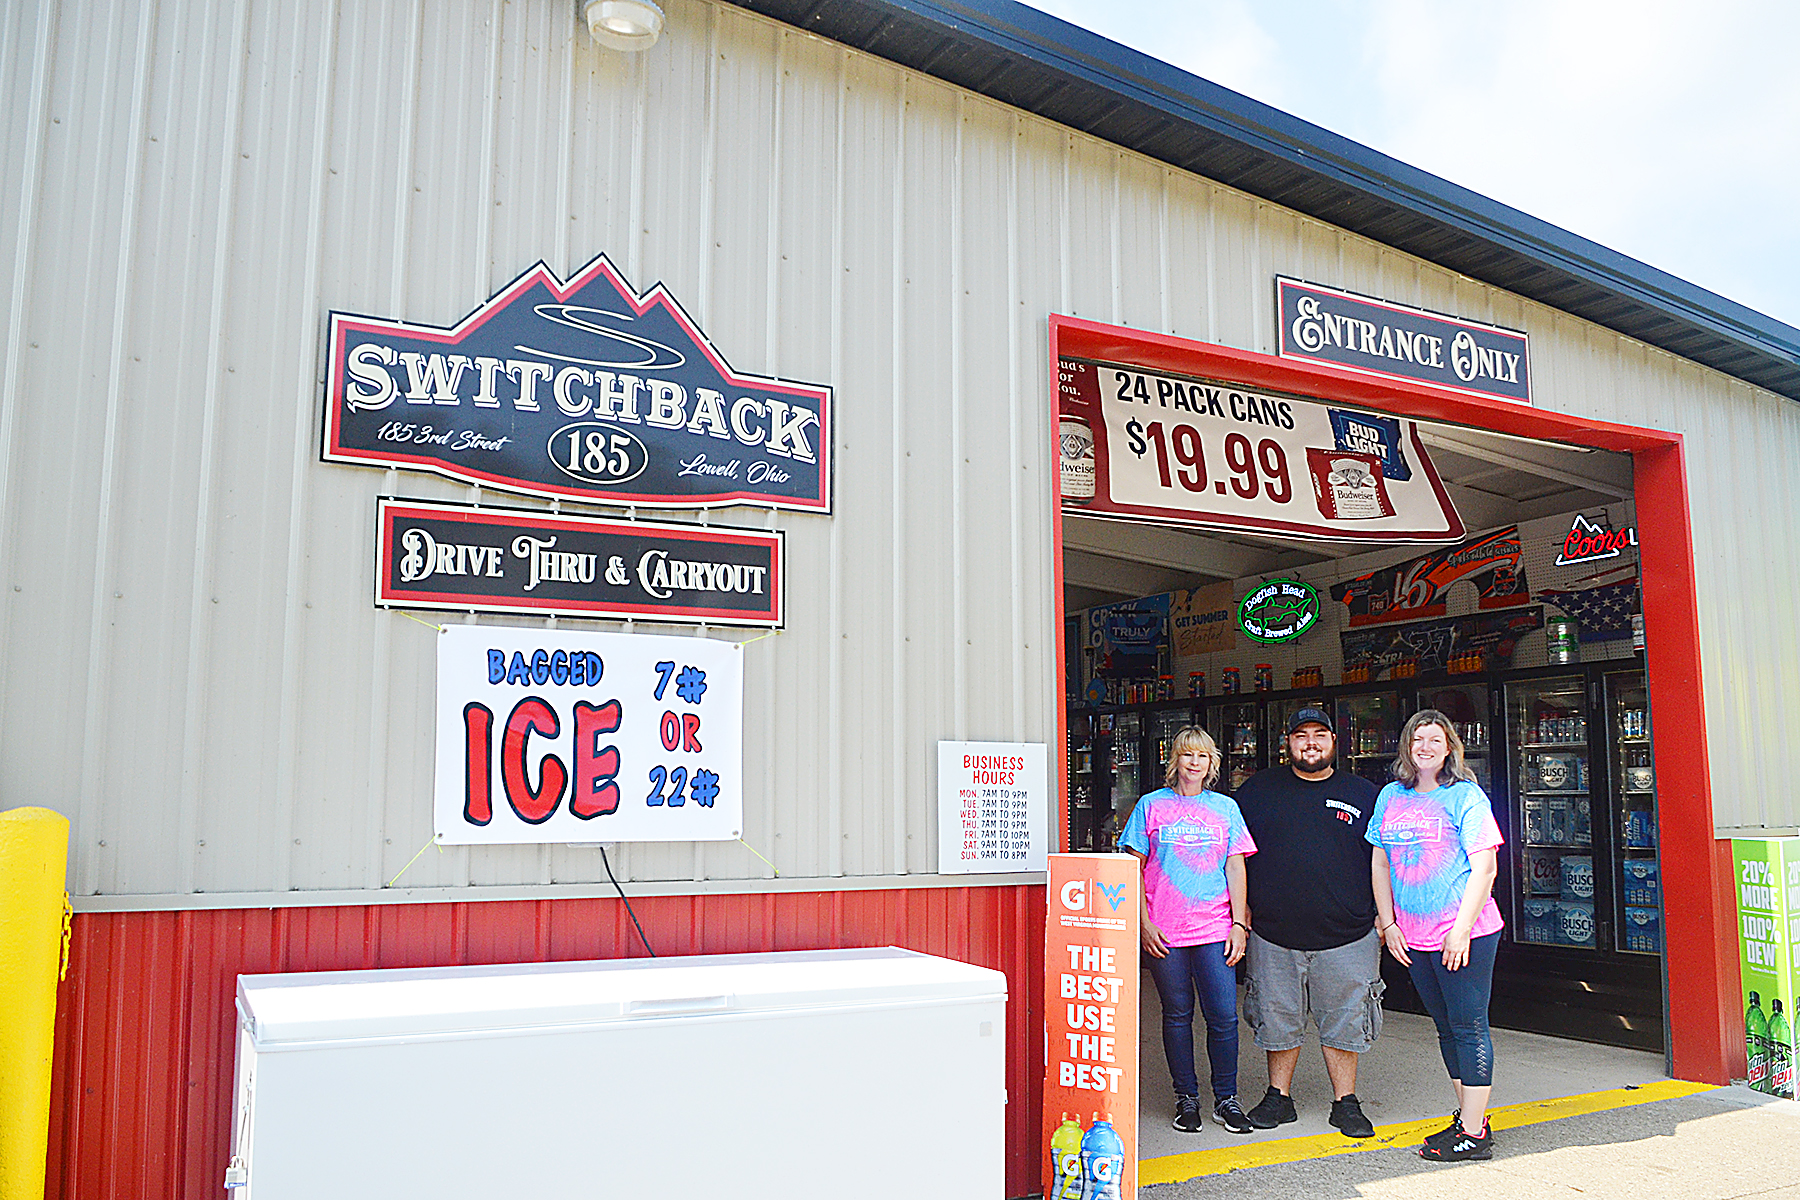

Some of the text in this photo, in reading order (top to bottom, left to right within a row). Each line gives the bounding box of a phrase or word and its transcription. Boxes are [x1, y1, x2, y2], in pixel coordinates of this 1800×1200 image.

[1292, 296, 1520, 384] ENTRANCE ONLY
[1058, 361, 1086, 373] ud's
[1058, 369, 1074, 382] or
[346, 343, 820, 464] SWITCHBACK
[1115, 371, 1295, 430] 24 PACK CANS
[377, 420, 513, 452] 185 3rd Street
[1348, 421, 1379, 443] BUD
[567, 429, 631, 477] 185
[1125, 416, 1292, 504] $19.99
[1345, 434, 1388, 459] LIGHT
[678, 453, 791, 486] Lowell, Ohio
[1337, 489, 1374, 500] Budweiser
[1563, 527, 1630, 559] Coors
[400, 528, 766, 599] DRIVE THRU & CARRYOUT
[1245, 584, 1306, 611] Dogfish Head
[1111, 626, 1151, 637] TRULY
[1175, 616, 1191, 629] GET
[1192, 610, 1229, 626] SUMMER
[487, 648, 605, 687] BAGGED
[659, 710, 702, 753] OR
[463, 695, 622, 827] ICE
[963, 754, 1024, 771] BUSINESS
[1540, 767, 1569, 778] BUSCH
[646, 765, 721, 809] 22#
[972, 770, 1015, 785] HOURS
[959, 789, 1028, 799] MON. 7AM TO 9PM
[963, 799, 1027, 809] TUE. 7AM TO 9PM
[960, 809, 1027, 819] WED. 7AM TO 9PM
[962, 819, 1027, 829] THU. 7AM TO 9PM
[963, 840, 1030, 850] SAT. 9AM TO 10PM
[964, 830, 1029, 840] FRI. 7AM TO 10PM
[960, 851, 1027, 860] SUN. 9AM TO 8PM
[1741, 860, 1774, 886] 20%
[1741, 884, 1779, 911] MORE
[1561, 917, 1595, 932] BUSCH
[1742, 915, 1782, 944] 100%
[1066, 944, 1117, 974] THE
[1060, 973, 1124, 1004] BEST
[1066, 1003, 1116, 1034] USE
[1065, 1033, 1116, 1064] THE
[1059, 1061, 1123, 1094] BEST
